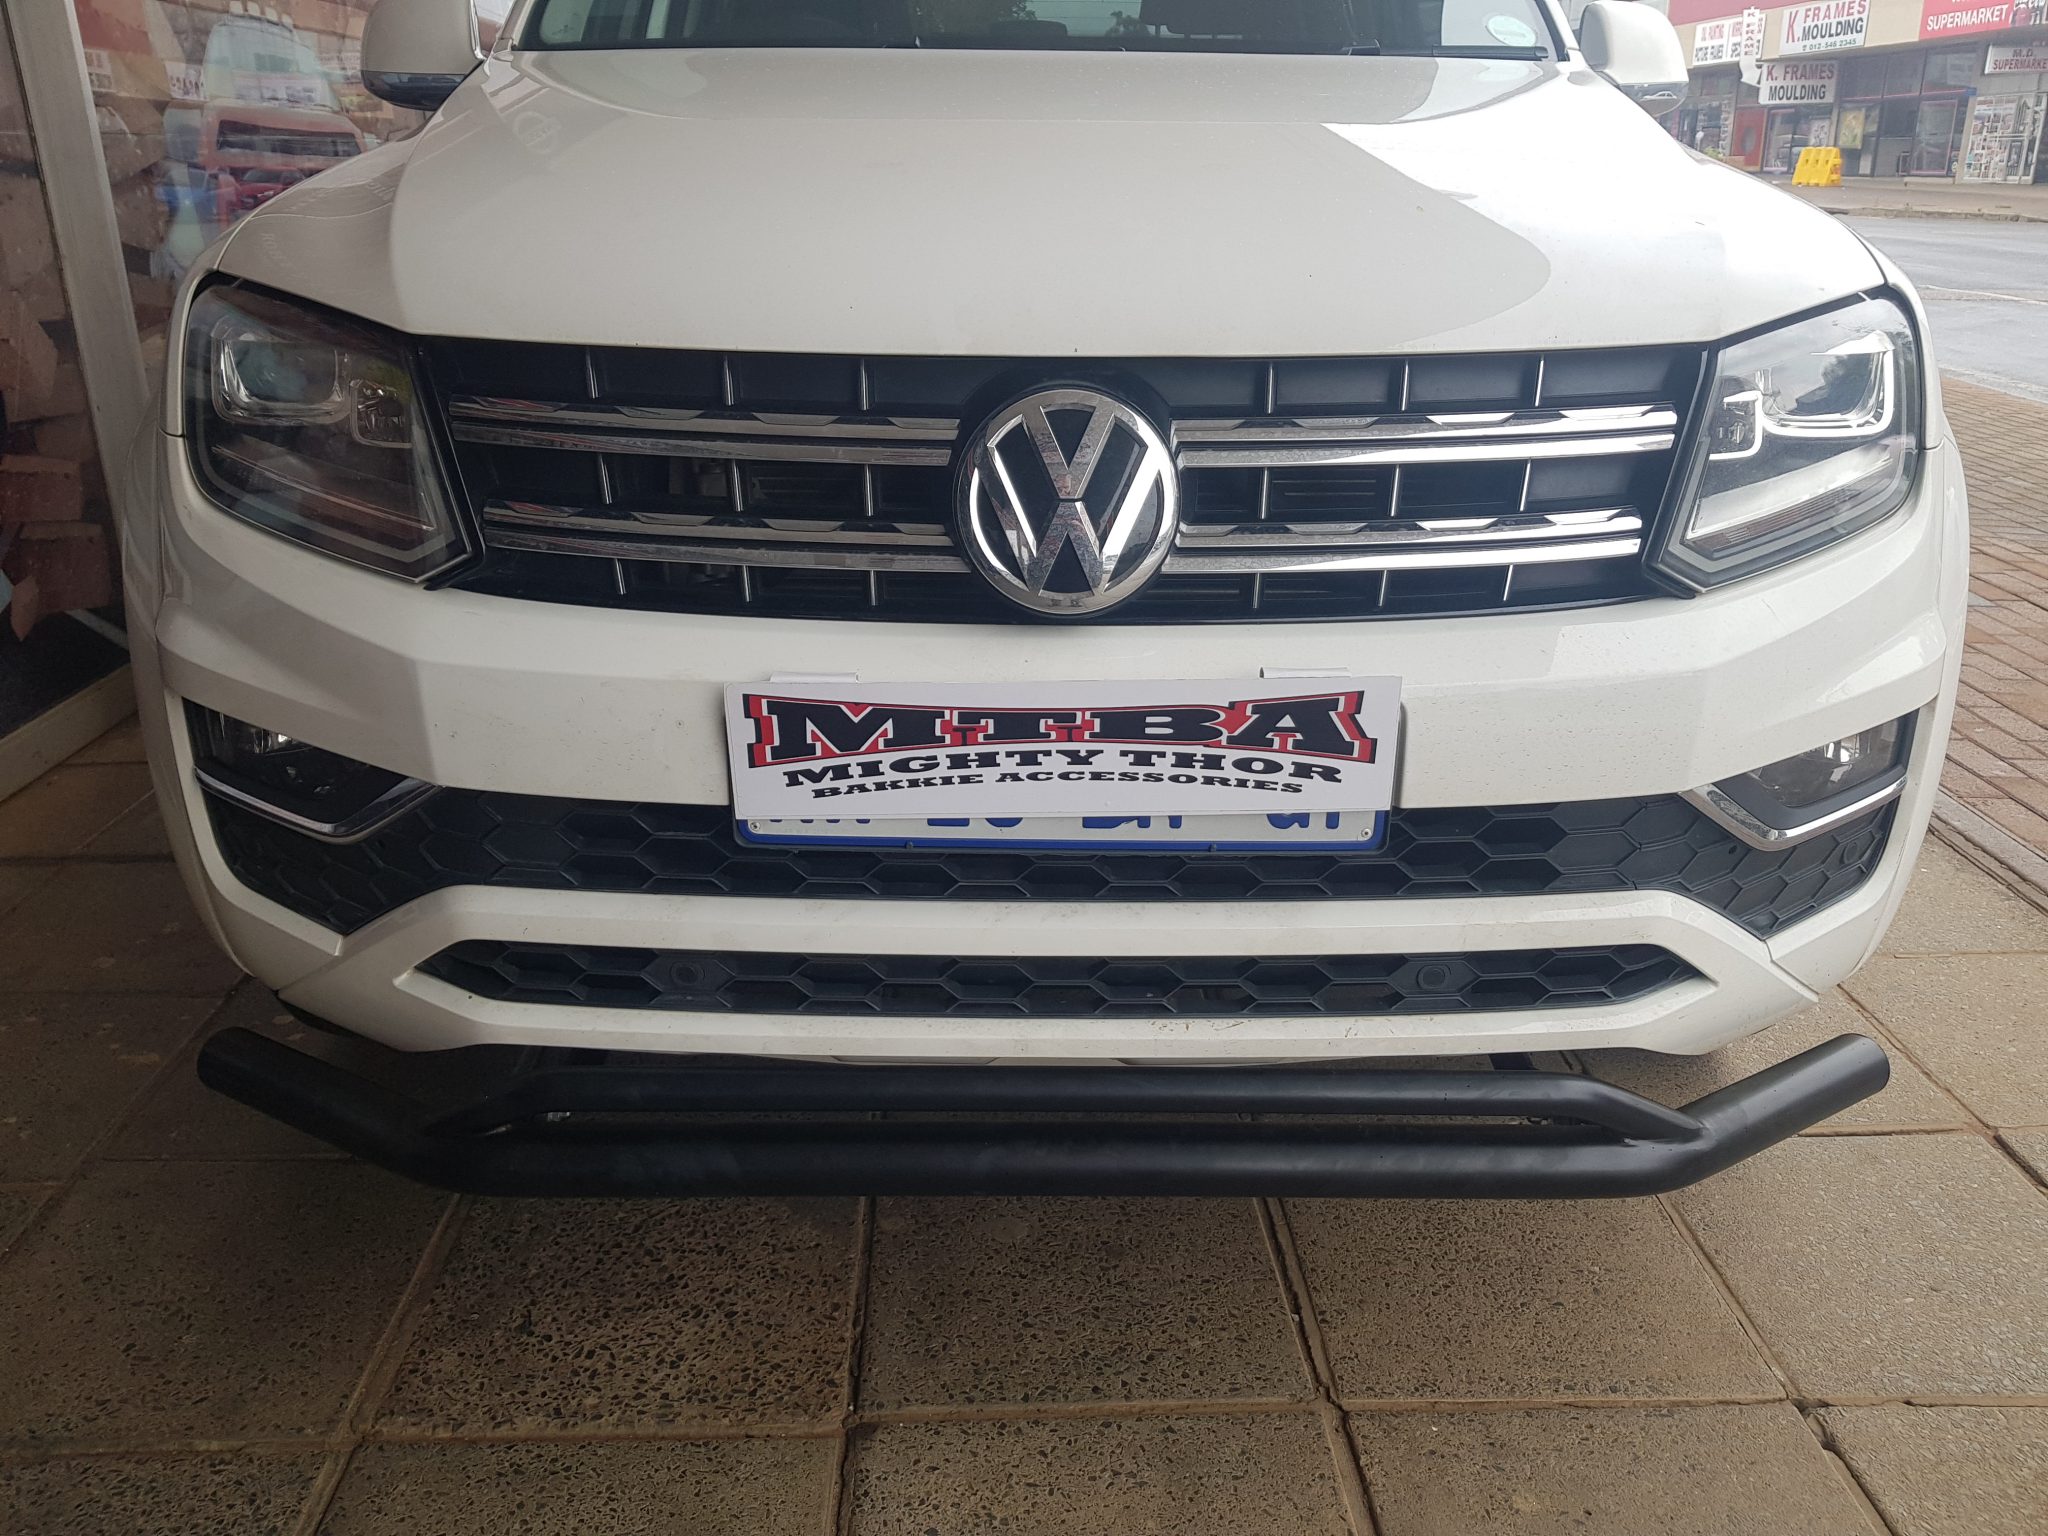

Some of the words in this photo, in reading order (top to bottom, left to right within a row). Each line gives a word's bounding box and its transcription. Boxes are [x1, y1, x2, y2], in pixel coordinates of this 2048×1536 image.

[1803, 0, 1867, 23] FRAMES
[1926, 4, 2009, 31] SUPERMARKET
[1801, 17, 1864, 42] MOULDING
[1783, 63, 1835, 81] FRAMES
[1993, 58, 2048, 71] SUPERMARKE
[1768, 84, 1826, 101] MOULDING
[742, 690, 1378, 769] MTBA
[783, 749, 1104, 788] MIGHTY
[1119, 750, 1342, 783] THOR
[812, 773, 984, 799] BAKKIE
[995, 771, 1303, 794] ACCESSORIES
